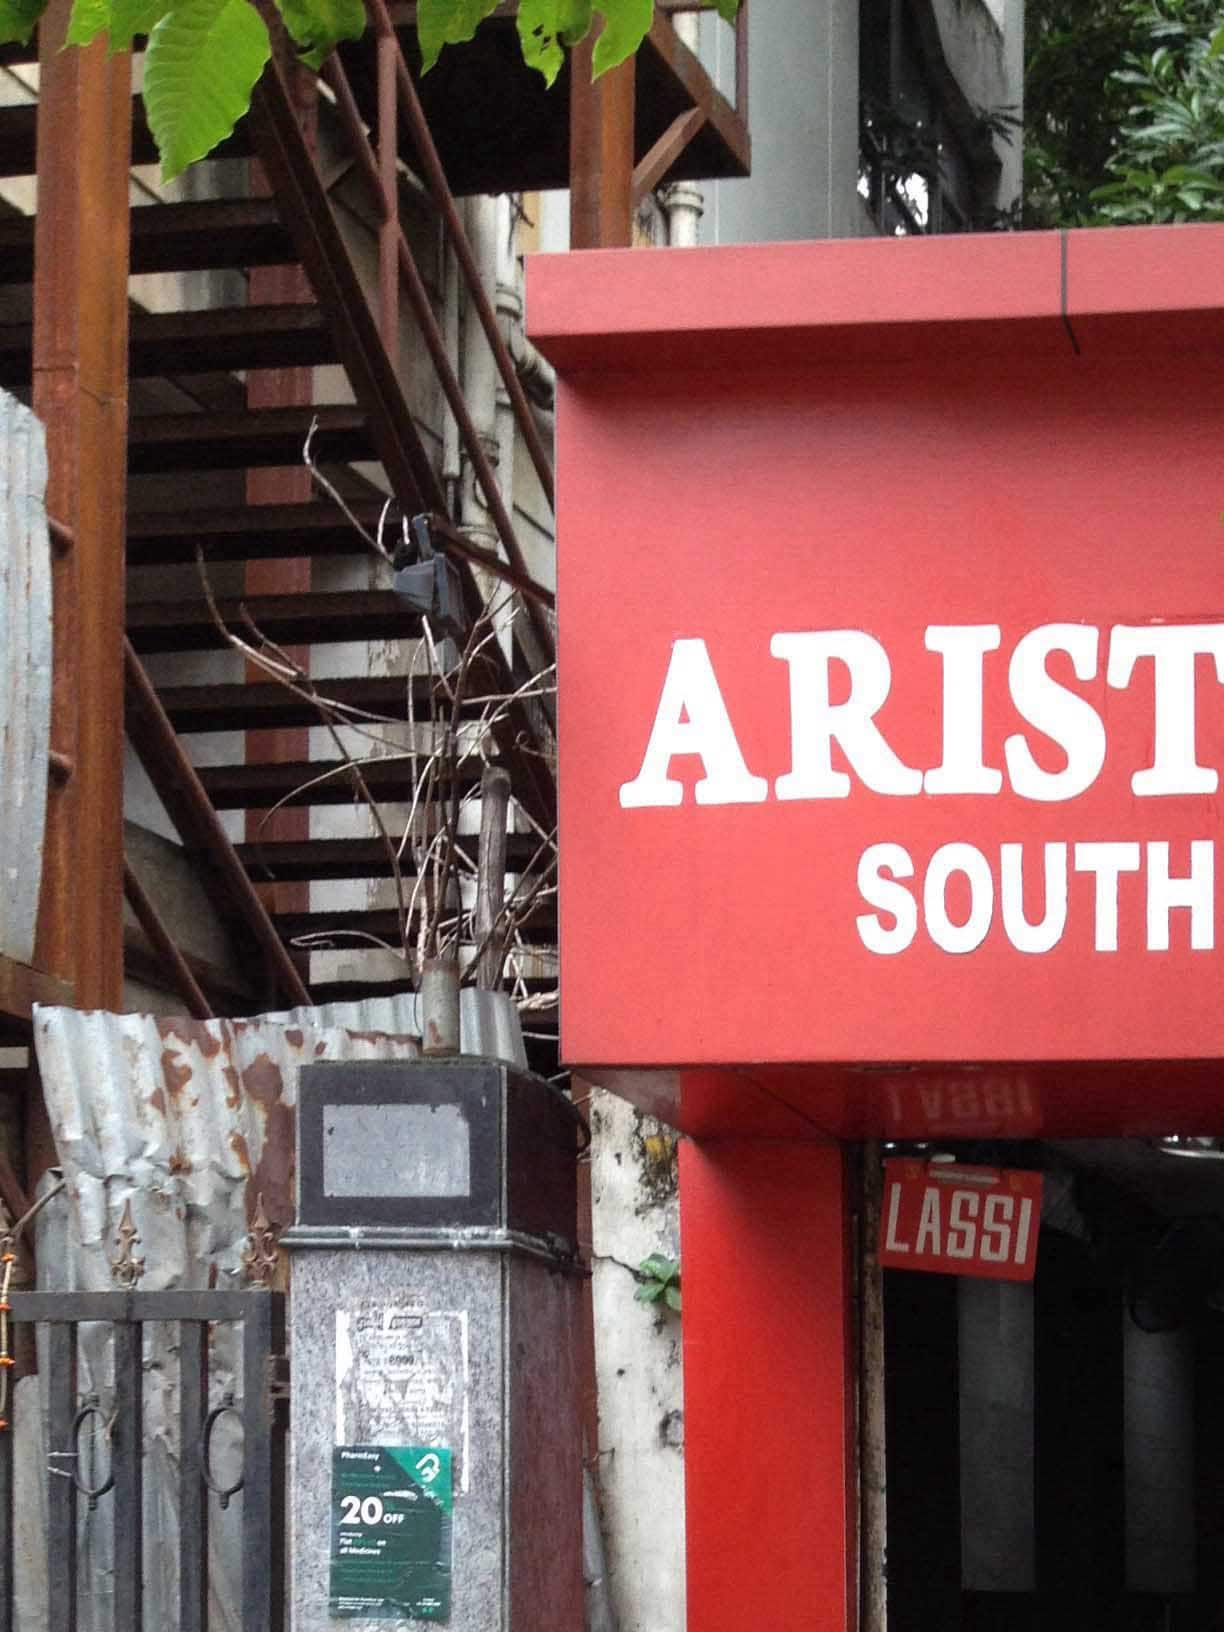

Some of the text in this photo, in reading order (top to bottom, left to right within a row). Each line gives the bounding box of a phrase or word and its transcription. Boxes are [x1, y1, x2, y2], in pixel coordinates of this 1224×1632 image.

[856, 838, 1215, 954] SOUTH
[885, 1182, 1033, 1265] LASSI
[340, 1495, 405, 1525] 20 OFF
